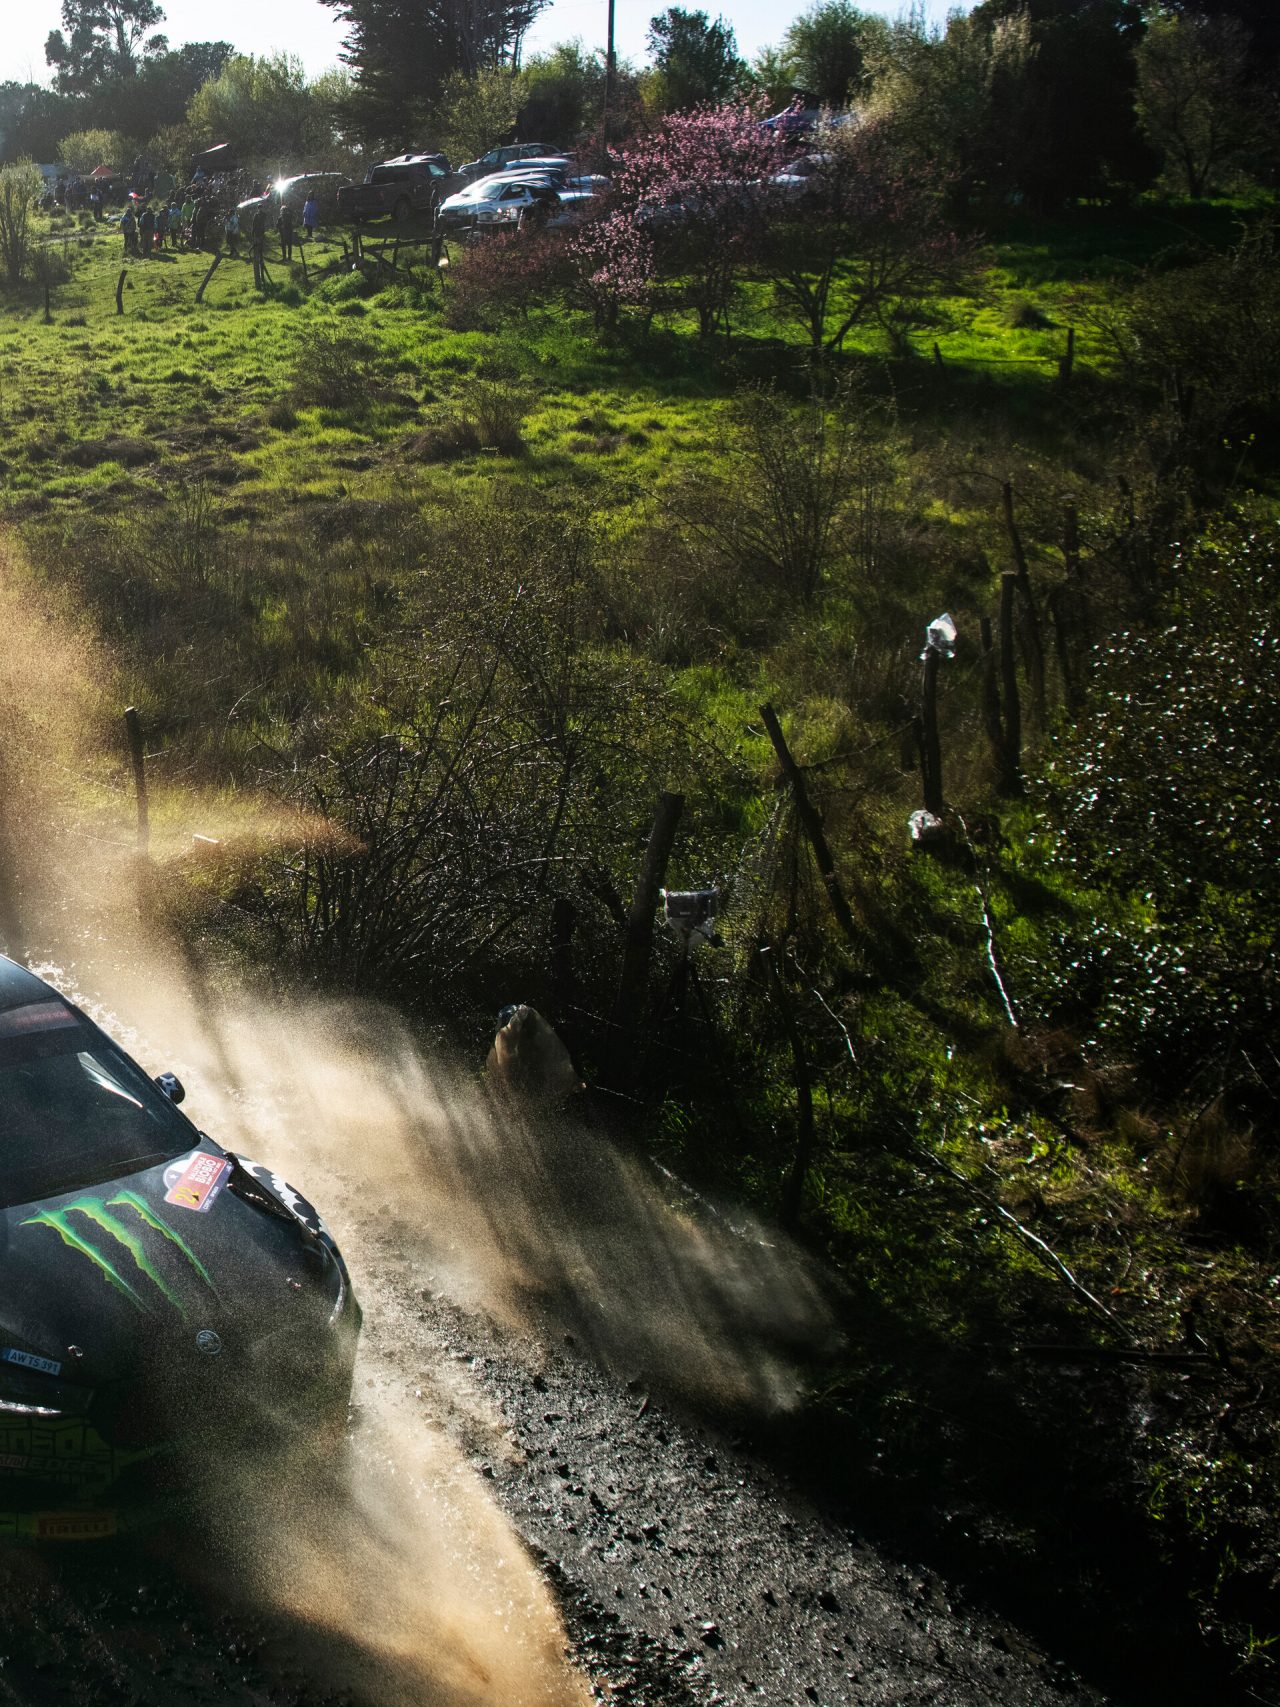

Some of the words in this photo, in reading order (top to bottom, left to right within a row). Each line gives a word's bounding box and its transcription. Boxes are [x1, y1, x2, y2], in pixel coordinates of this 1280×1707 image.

[10, 1351, 27, 1363] AW
[28, 1356, 40, 1367] TS
[41, 1360, 59, 1372] 391
